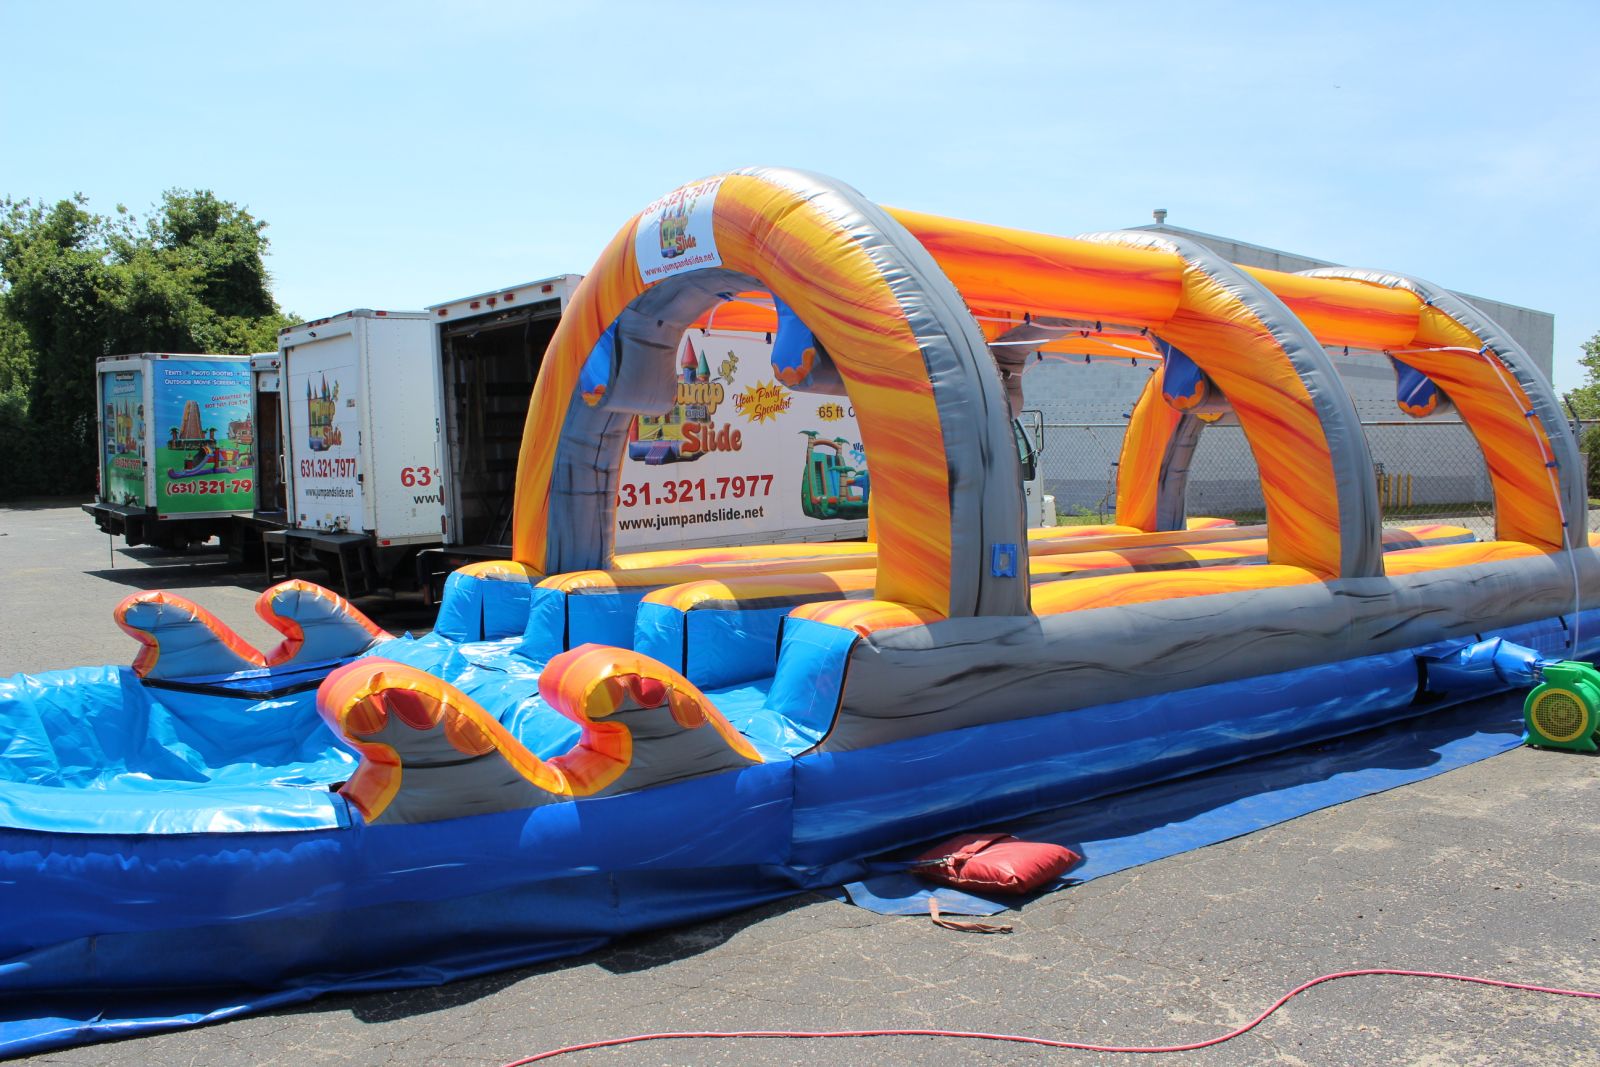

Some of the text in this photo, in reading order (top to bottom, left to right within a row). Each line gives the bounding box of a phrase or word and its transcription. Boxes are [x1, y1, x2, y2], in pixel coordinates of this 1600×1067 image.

[644, 252, 715, 276] www.jumpandslide.net
[676, 382, 725, 416] ump
[732, 385, 781, 412] Your Party
[753, 397, 794, 422] Specialist
[685, 405, 706, 419] and
[818, 406, 833, 418] 65
[836, 406, 844, 418] ft
[681, 421, 743, 454] Slide
[166, 481, 197, 496] (631)
[615, 474, 774, 509] 31.321.7977
[618, 505, 764, 531] www.jumpandslide.net
